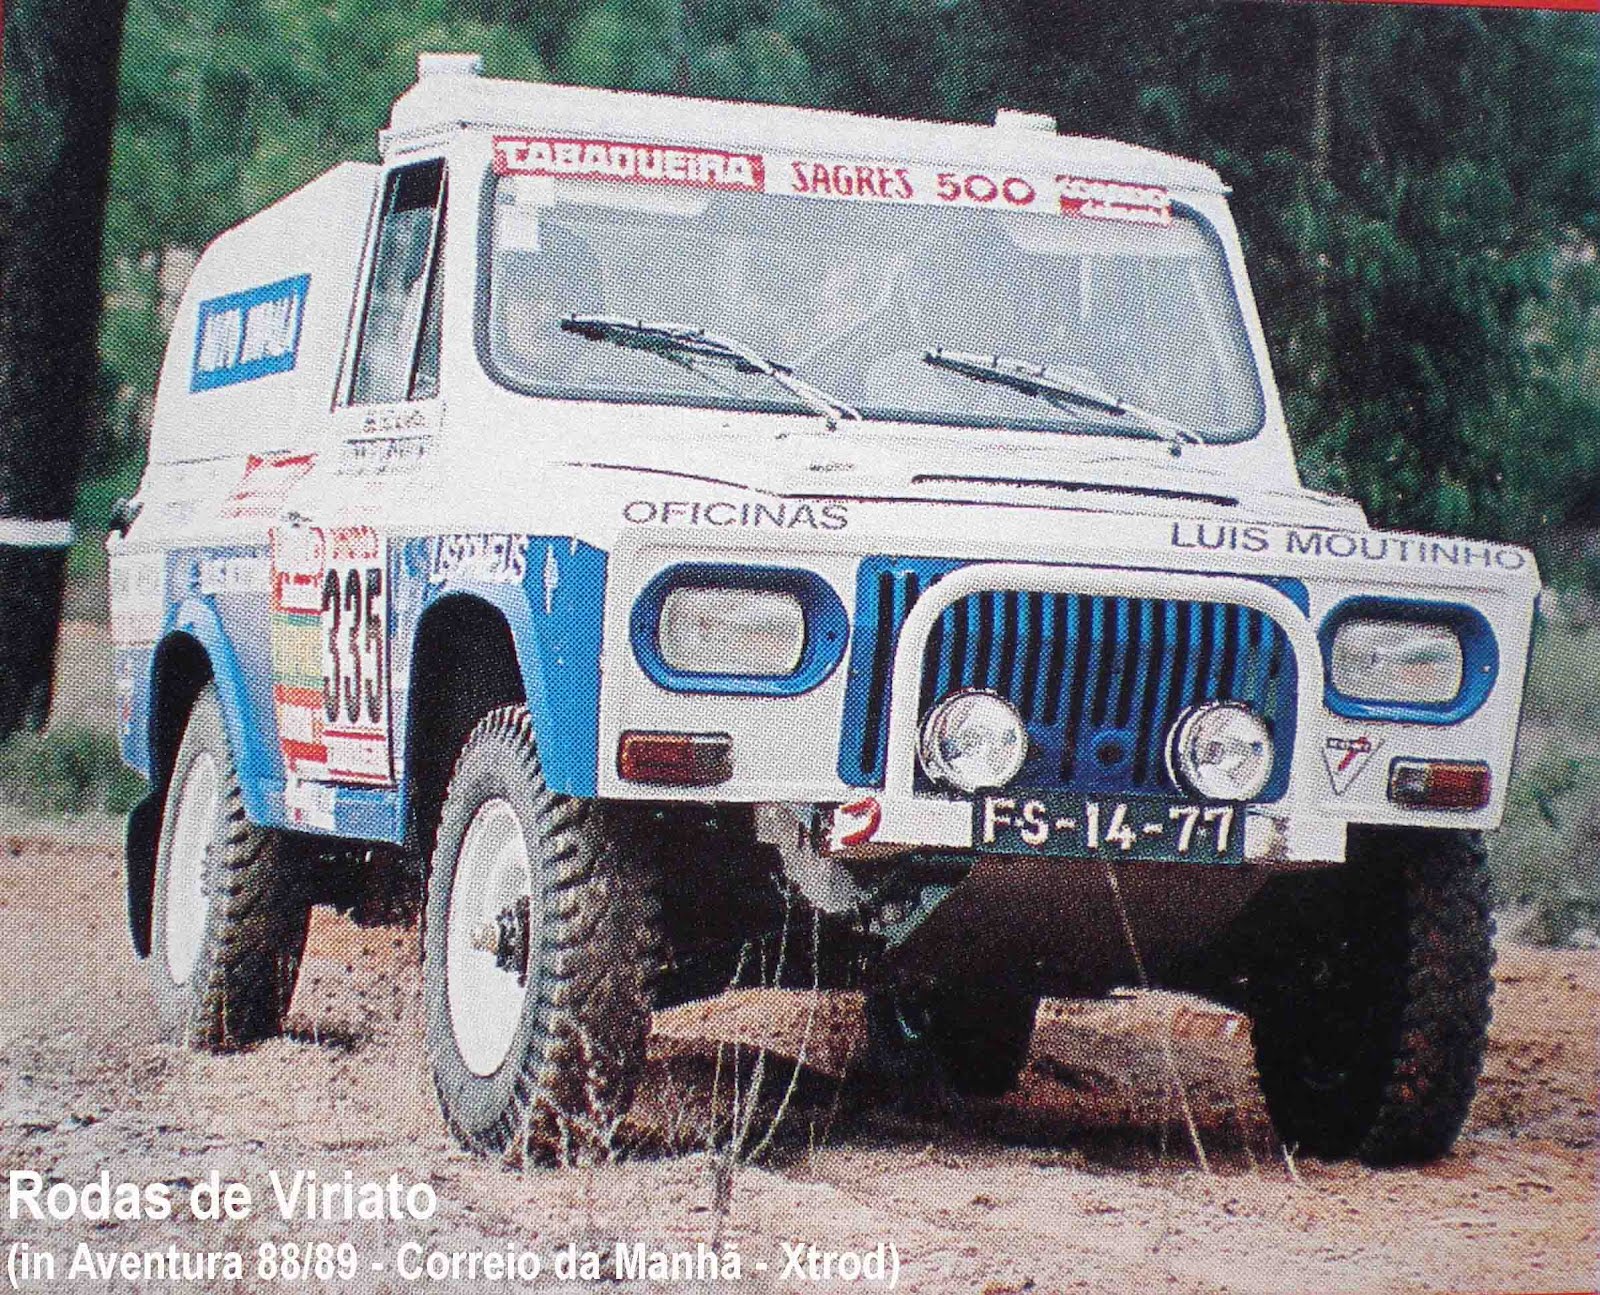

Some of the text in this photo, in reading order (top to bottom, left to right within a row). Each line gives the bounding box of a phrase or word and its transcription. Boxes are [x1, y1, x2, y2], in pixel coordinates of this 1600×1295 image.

[792, 160, 914, 200] SAGRES
[936, 172, 1036, 207] 500
[623, 500, 848, 531] OFICINAS
[1171, 521, 1526, 571] LUIS MOUTINHO
[321, 567, 383, 724] 335
[980, 797, 1236, 854] FS-14-77
